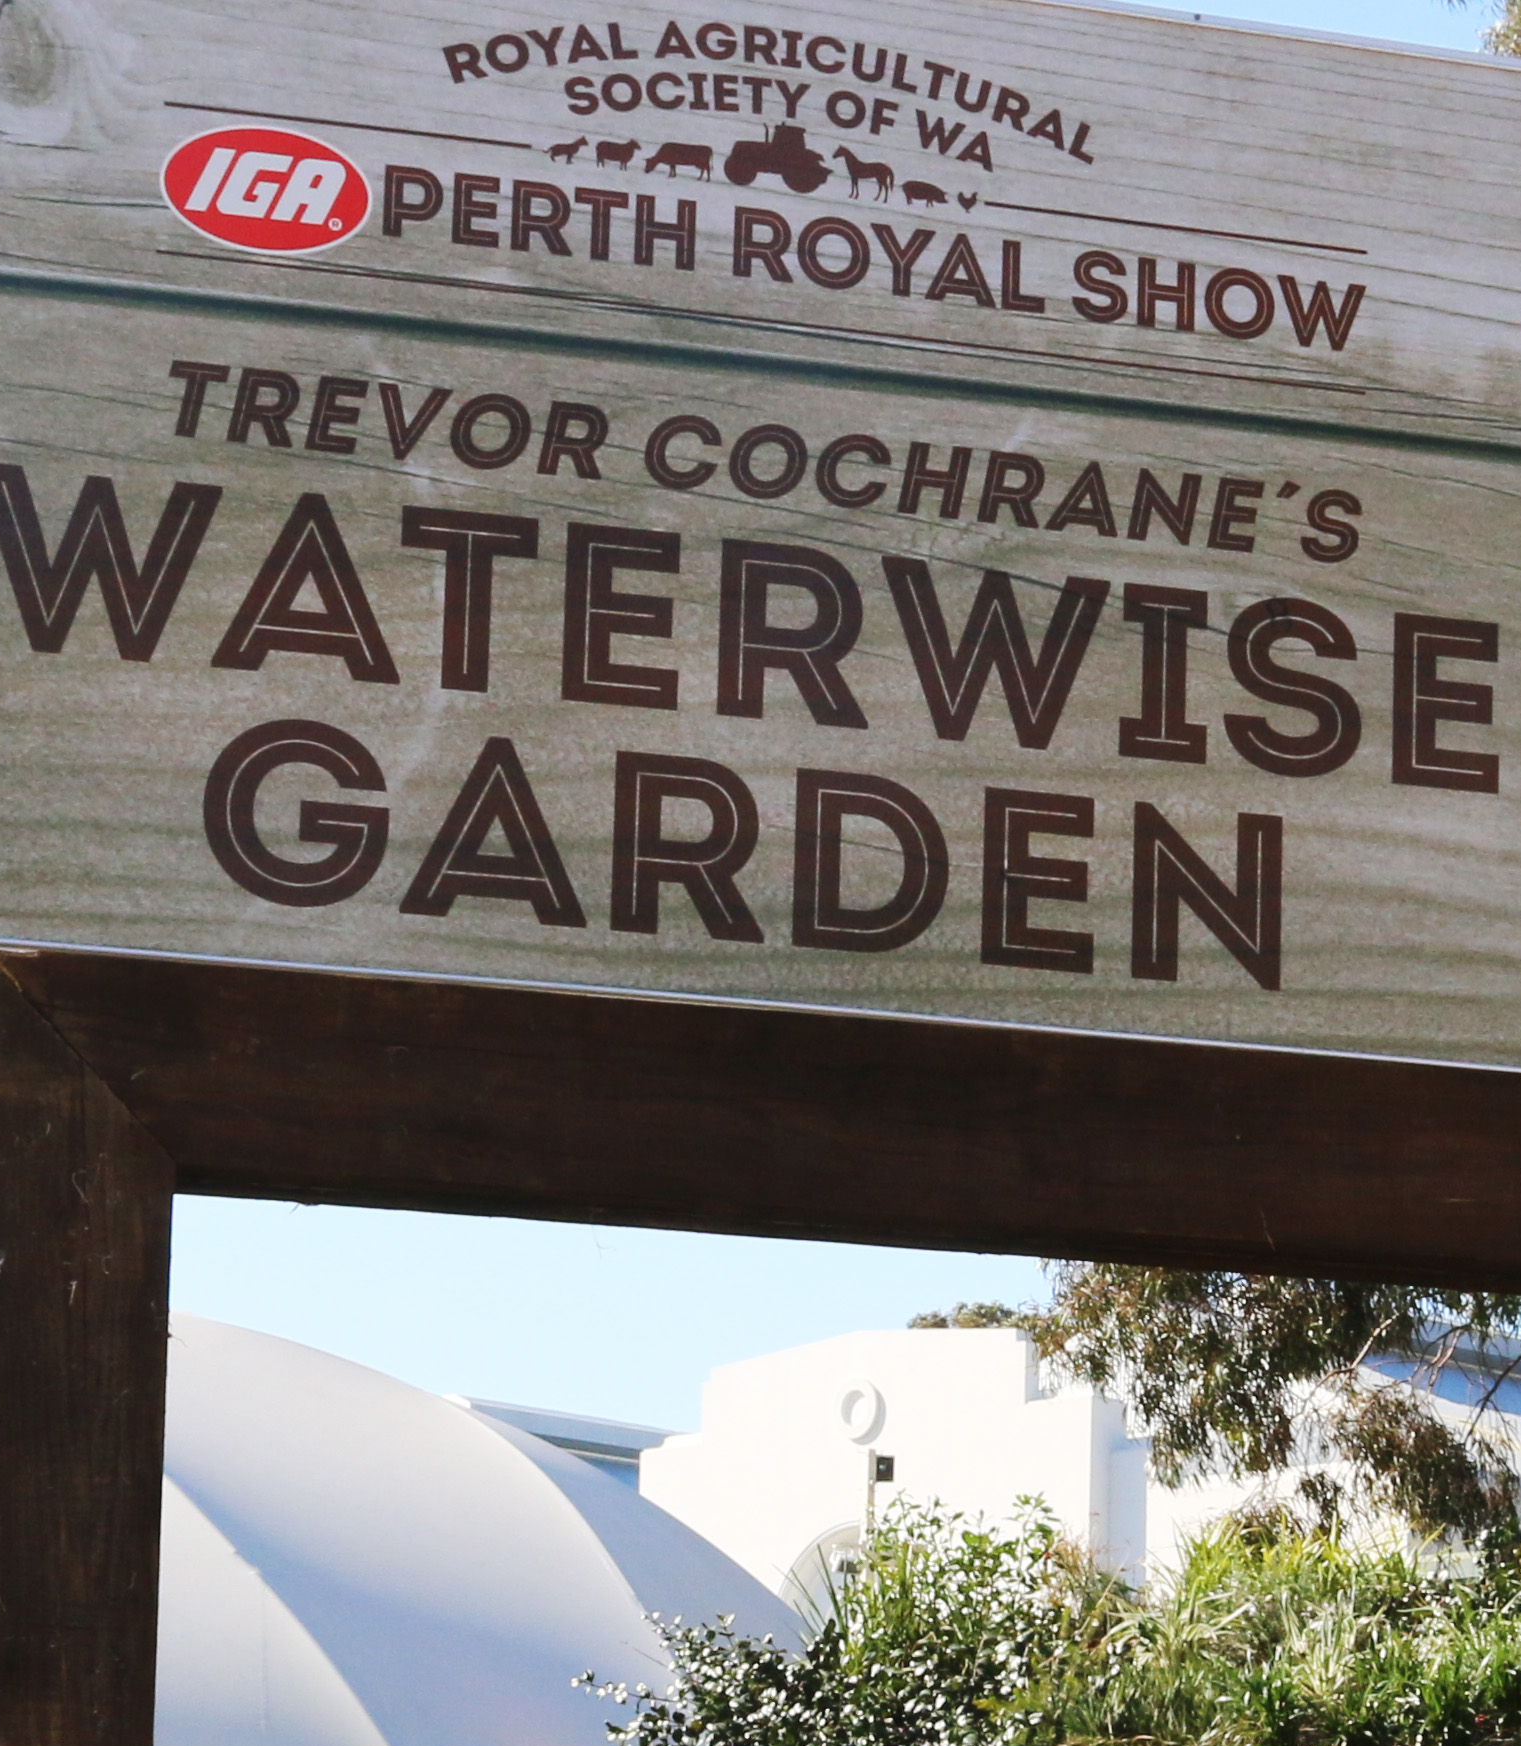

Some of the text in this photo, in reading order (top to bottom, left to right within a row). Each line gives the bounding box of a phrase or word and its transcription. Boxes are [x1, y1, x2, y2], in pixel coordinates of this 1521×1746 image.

[443, 20, 1096, 165] ROYAL AGRICULTURAL
[563, 72, 995, 173] SOCIETY OF WA
[184, 147, 347, 226] IGA
[381, 164, 1366, 353] PERTH ROYAL SHOW
[169, 359, 606, 480] TREVOR
[202, 718, 1284, 992] GARDEN
